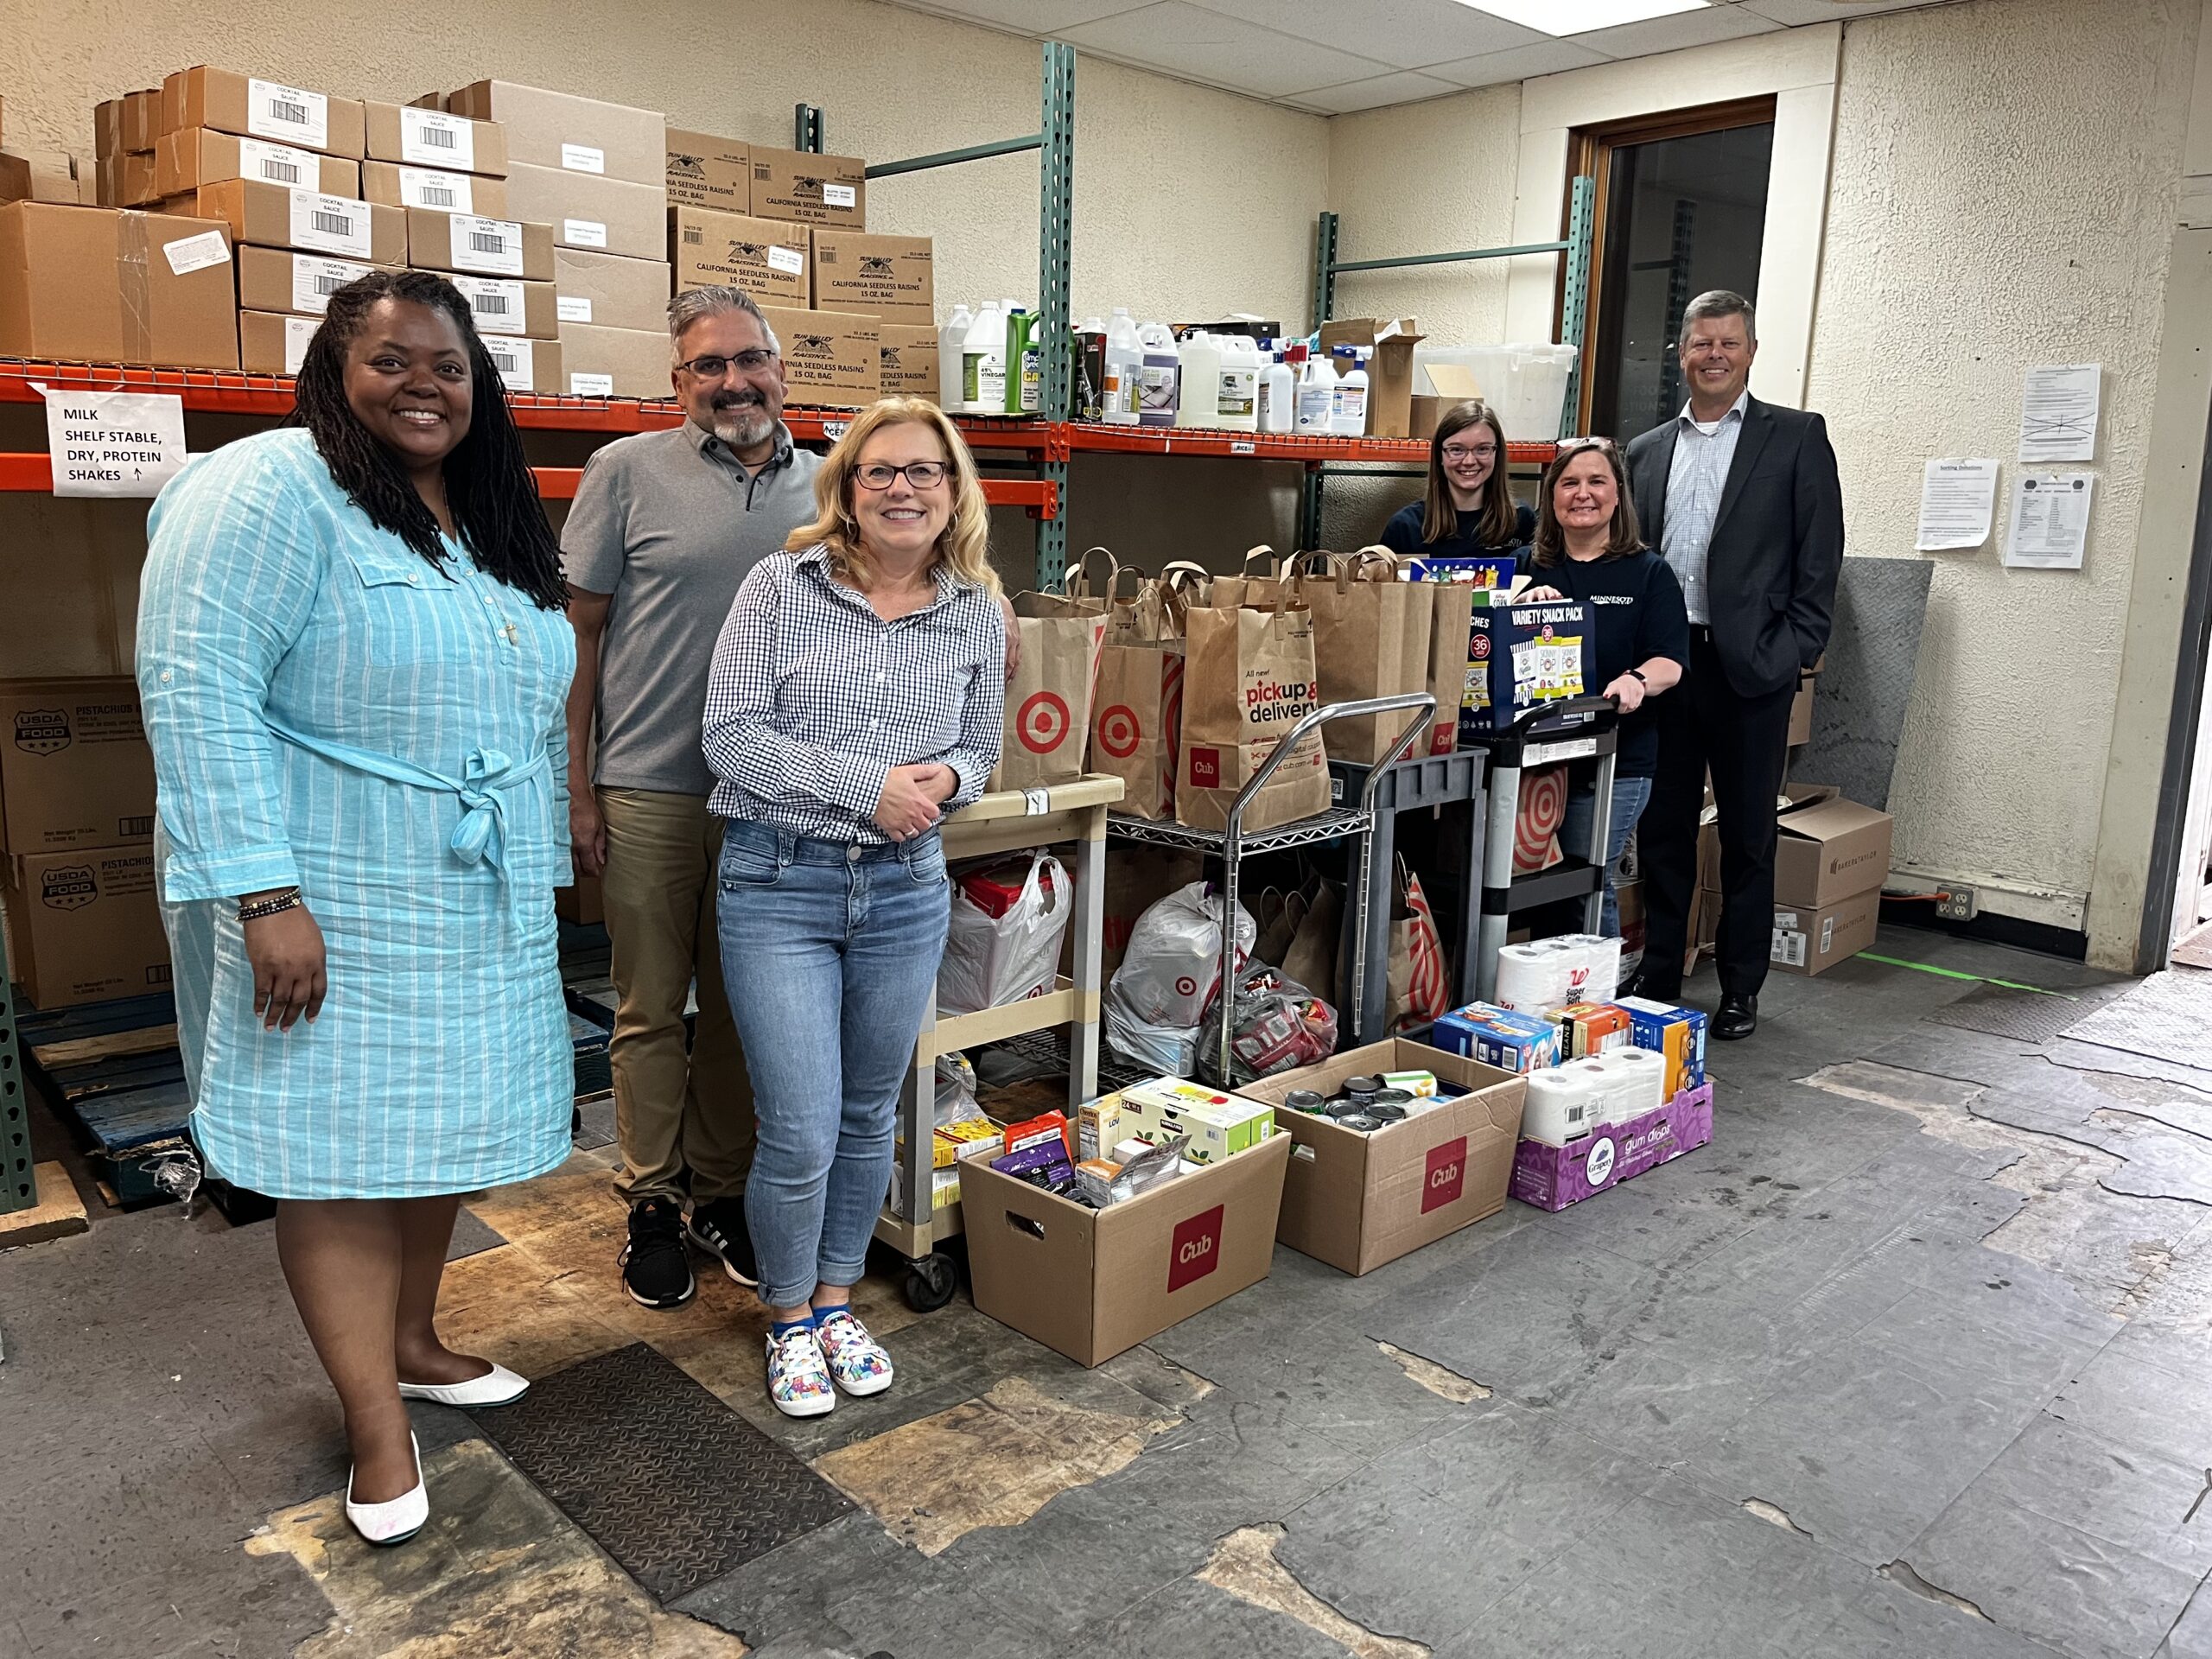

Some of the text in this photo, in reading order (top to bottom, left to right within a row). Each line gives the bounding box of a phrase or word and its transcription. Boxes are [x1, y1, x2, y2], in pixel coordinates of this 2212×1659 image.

[677, 181, 708, 191] SEEDLESS
[709, 187, 734, 196] RAISINS
[766, 197, 802, 207] CALIFORNIA
[803, 202, 830, 211] SEEDLESS
[696, 263, 796, 283] CALIFORNIA SEEDLESS RAISINS
[832, 280, 868, 289] CALIFORNIA
[869, 282, 897, 290] SEEDLESS
[804, 362, 836, 371] SEEDLESS
[838, 365, 865, 373] RAISINS
[1023, 372, 1039, 382] CA
[64, 409, 99, 421] MILK
[66, 430, 162, 445] SHELF STABLE,
[67, 450, 162, 463] DRY, PROTEIN
[68, 470, 121, 481] SHAKES
[1512, 607, 1583, 626] VARIETY SNACK PACK
[1473, 639, 1487, 651] 36
[1541, 658, 1556, 671] POP
[1562, 657, 1577, 669] POP
[1246, 681, 1317, 708] pickup &
[76, 705, 133, 715] PISTACHIOS
[20, 715, 62, 725] USDA
[22, 727, 65, 738] FOOD
[1195, 762, 1214, 775] Cub
[48, 871, 90, 881] USDA
[49, 883, 91, 895] FOOD
[1832, 914, 1866, 934] AKER&TAYLOR
[1566, 987, 1586, 998] Super
[1567, 995, 1581, 1006] Soft
[1109, 1117, 1120, 1128] LOV
[1625, 1125, 1670, 1155] gum drops
[1588, 1159, 1611, 1173] Grapery
[1431, 1165, 1457, 1190] Cub
[1179, 1234, 1211, 1265] Cub
